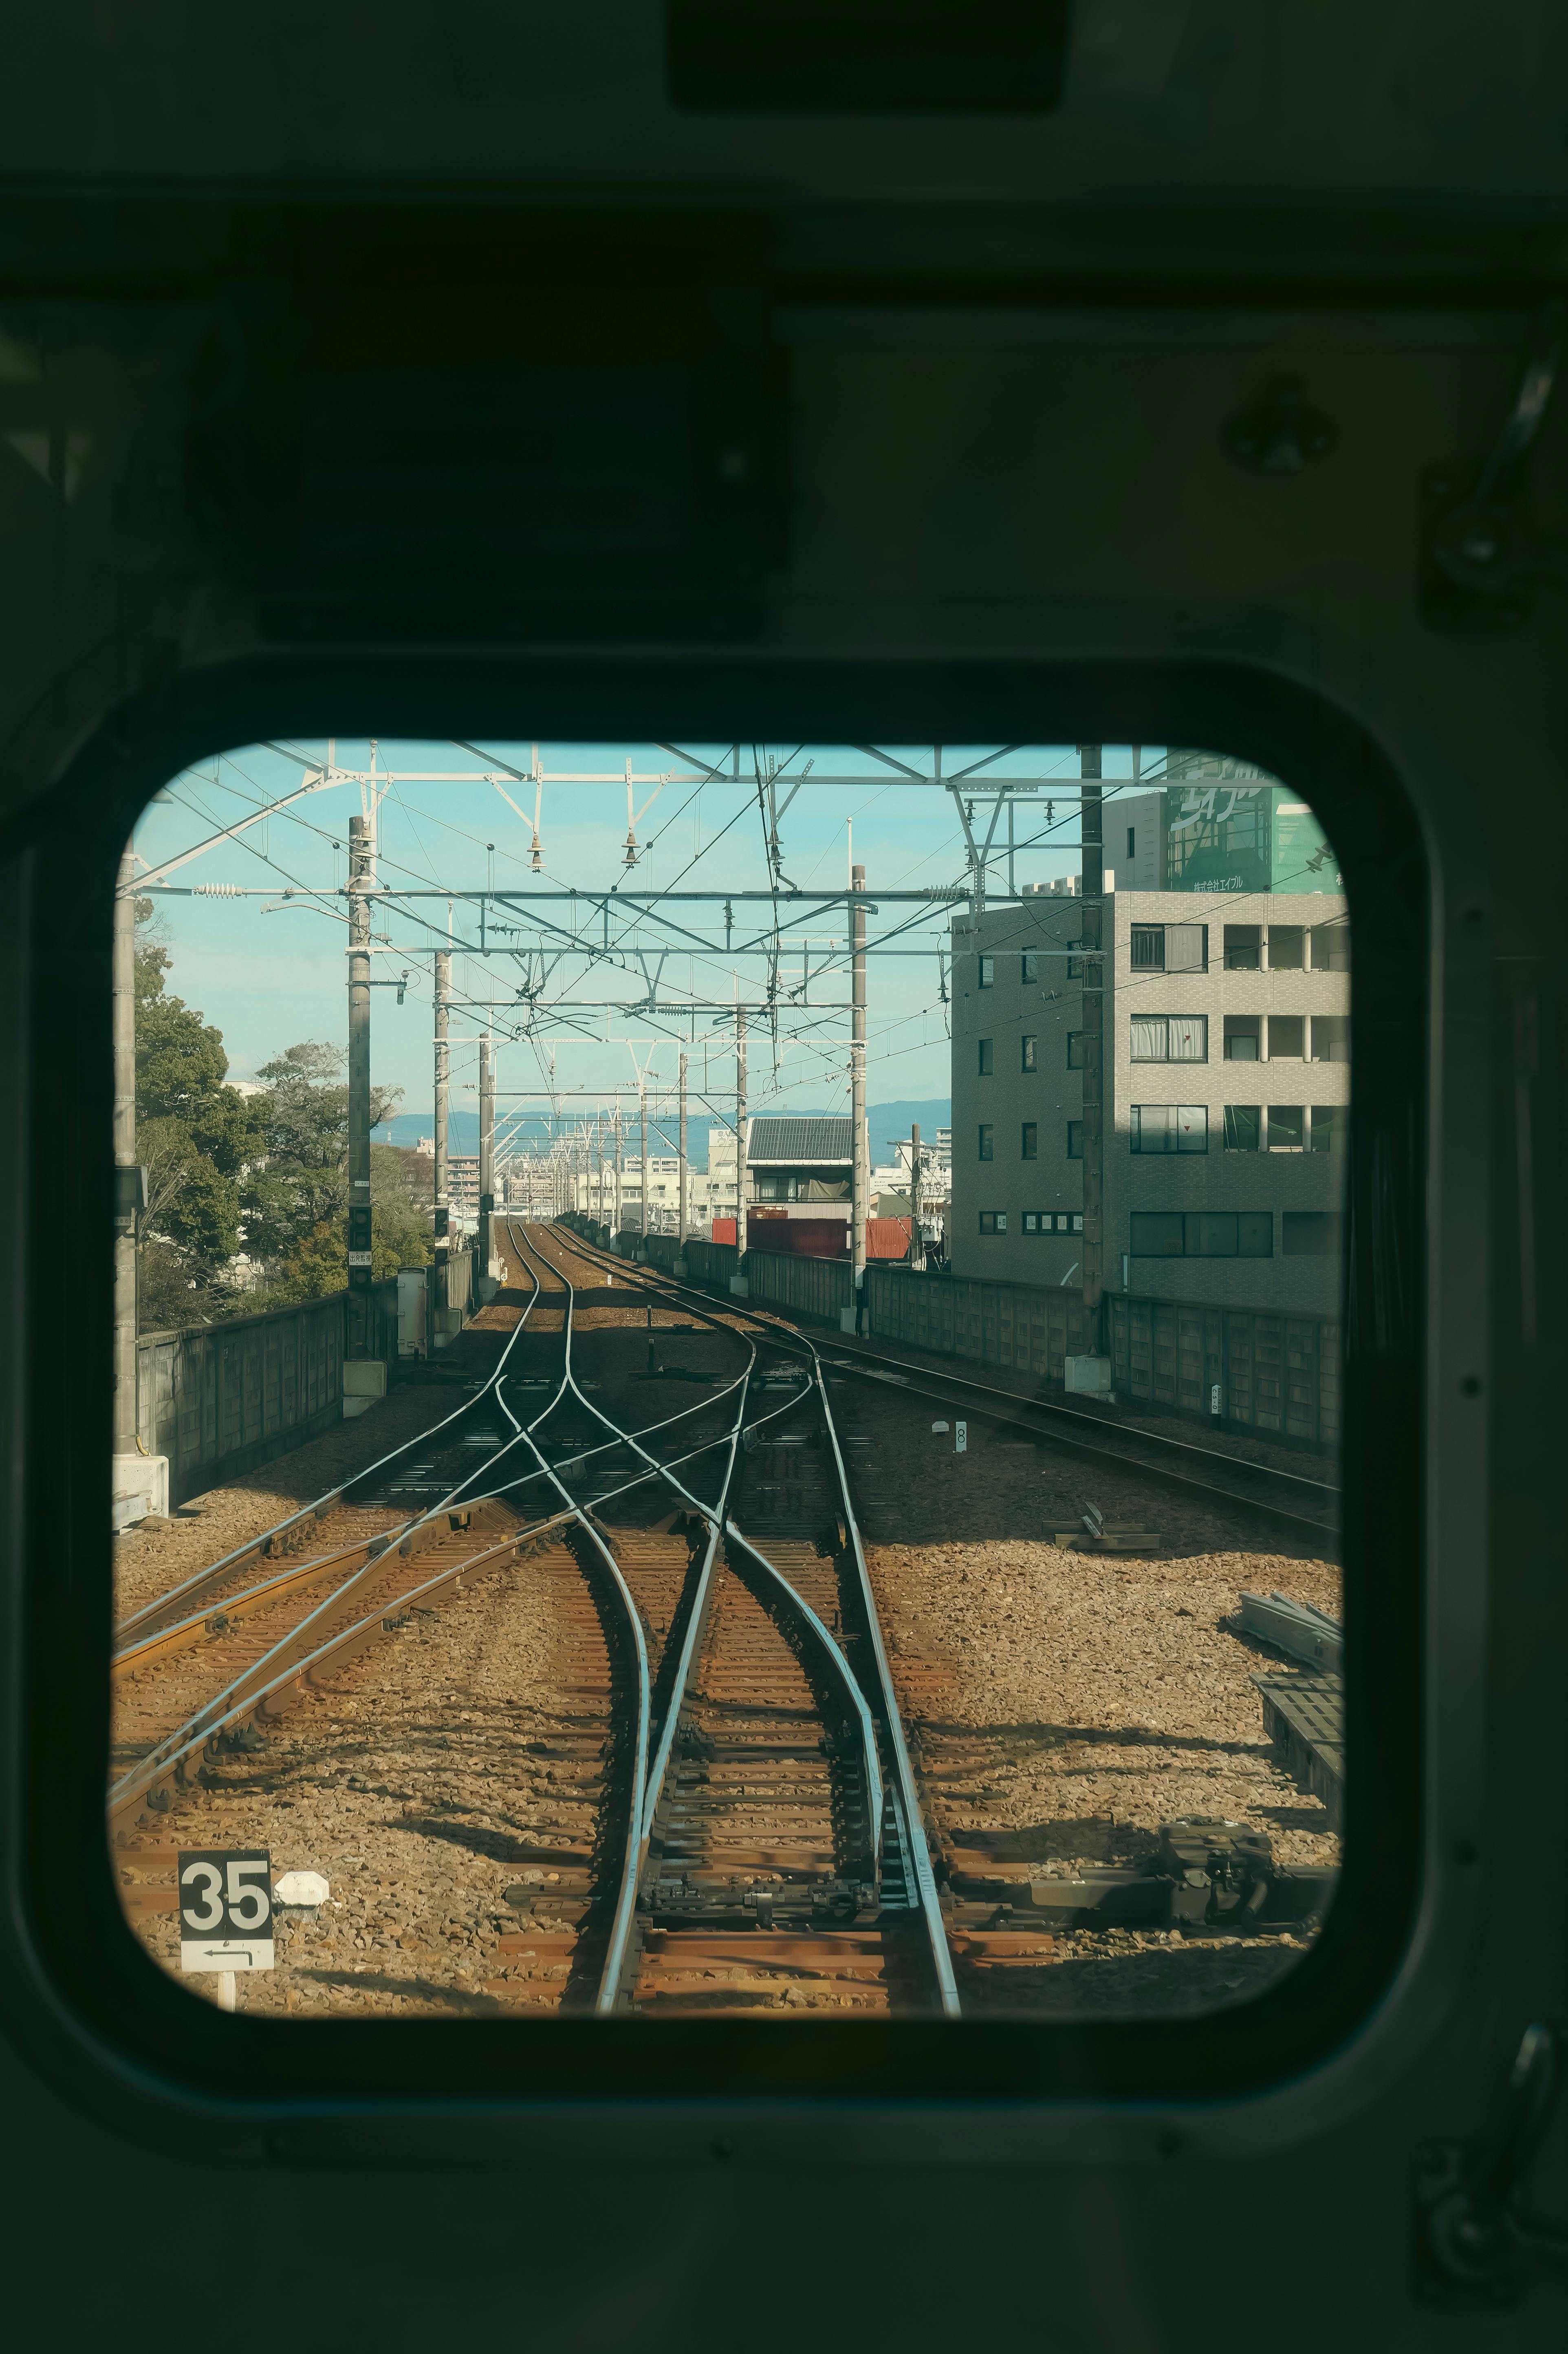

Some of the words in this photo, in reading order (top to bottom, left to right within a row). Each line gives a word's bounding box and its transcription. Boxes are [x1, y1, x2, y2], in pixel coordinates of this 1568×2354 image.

[1194, 875, 1243, 892] 株式会社エイブル
[958, 1429, 965, 1443] 8
[181, 1860, 269, 1930] 35
